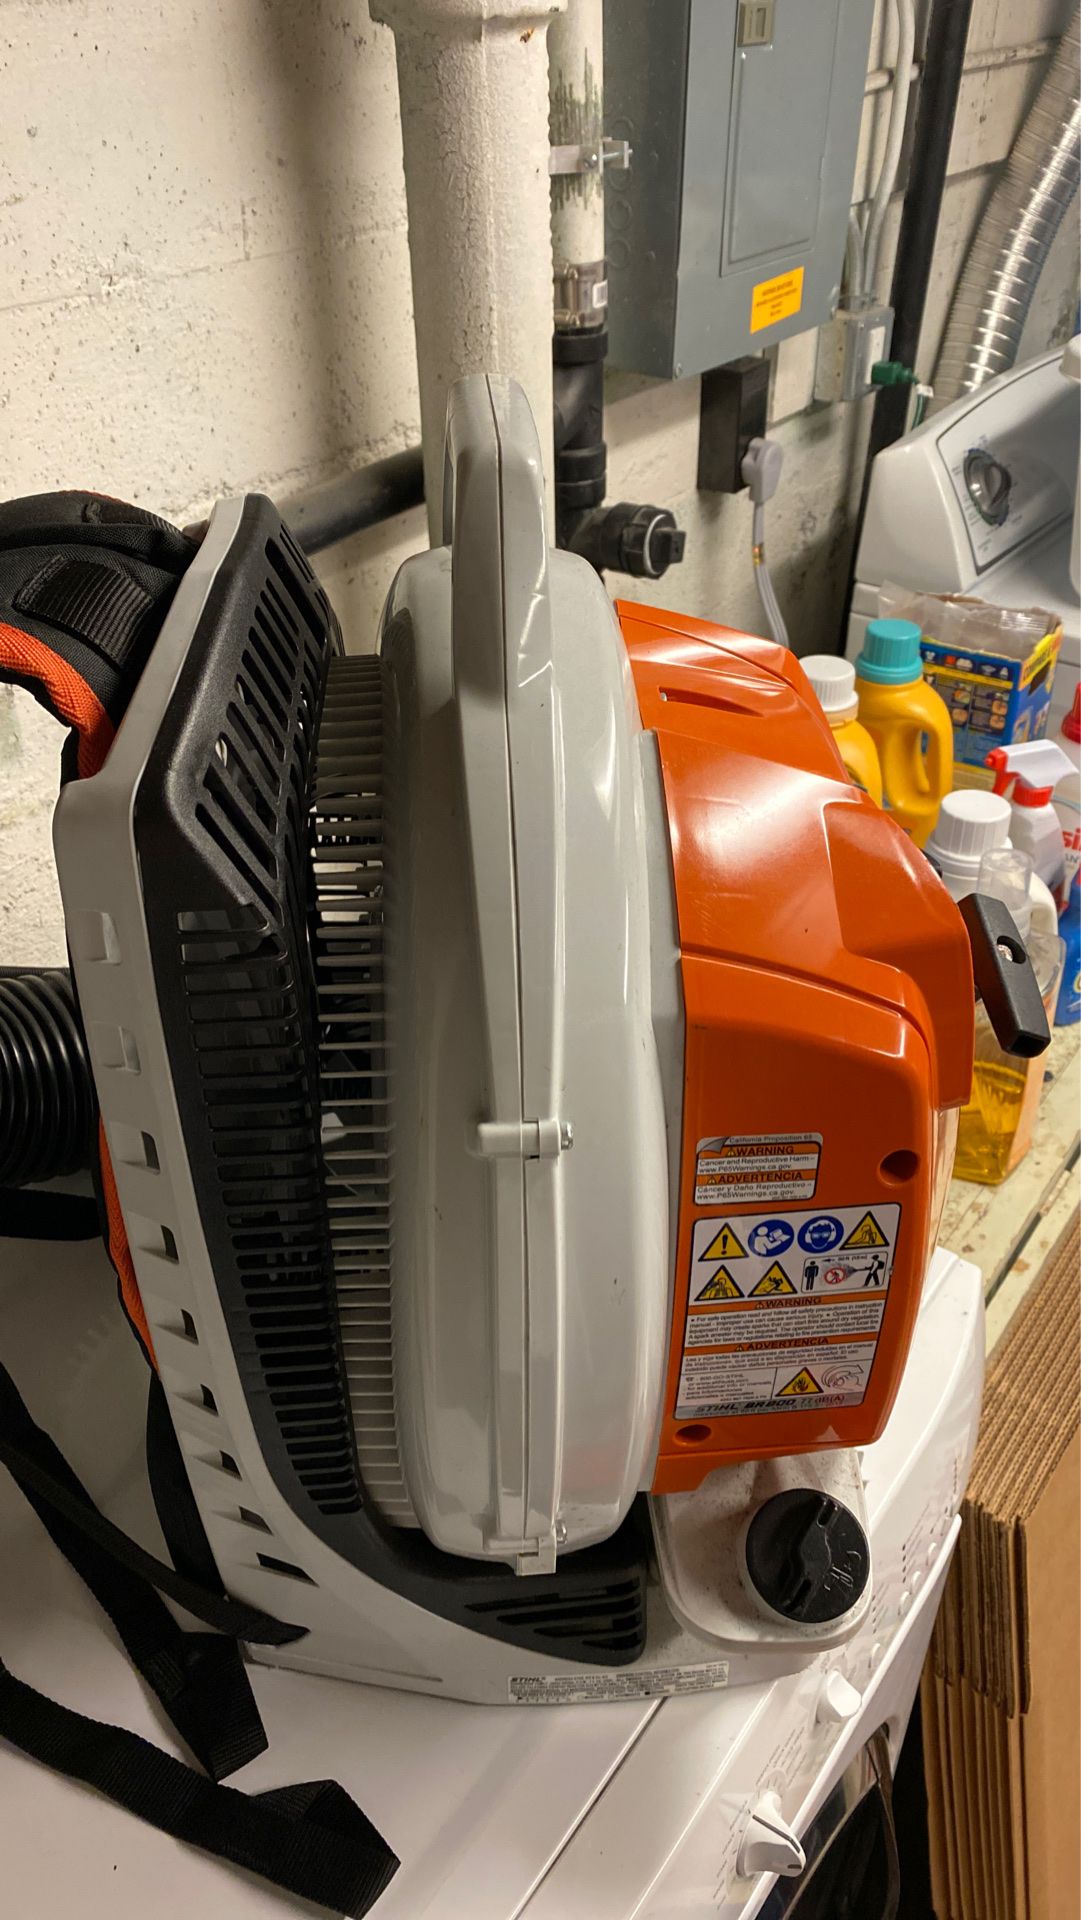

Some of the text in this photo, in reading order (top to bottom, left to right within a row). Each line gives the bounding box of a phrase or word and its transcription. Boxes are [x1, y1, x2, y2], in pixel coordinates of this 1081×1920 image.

[764, 1134, 802, 1142] Proposition
[736, 1145, 794, 1157] WARNING
[741, 1156, 788, 1166] Reproductive
[718, 1171, 802, 1184] ADVERTENCIA
[733, 1184, 754, 1192] Daño
[756, 1182, 806, 1192] Reproductivo
[766, 1297, 822, 1308] WARNING
[744, 1337, 829, 1351] ADVERTENCIA
[696, 1402, 738, 1412] STIHL
